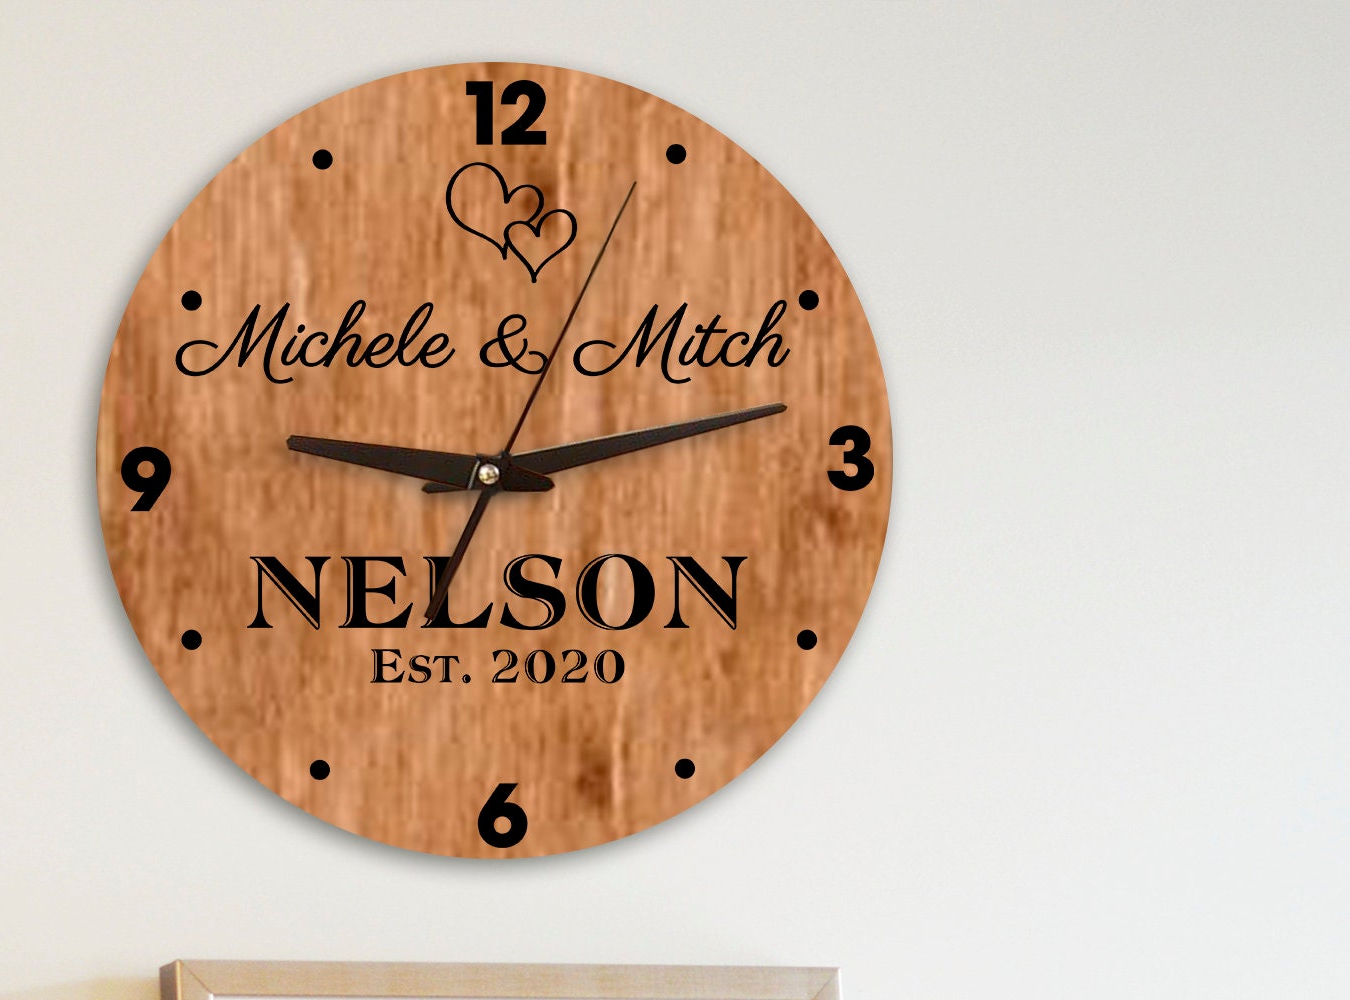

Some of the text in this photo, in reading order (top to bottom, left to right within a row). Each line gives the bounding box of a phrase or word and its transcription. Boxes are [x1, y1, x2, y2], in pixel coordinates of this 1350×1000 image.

[465, 79, 547, 146] 12
[175, 299, 792, 385] Michele & Mitch
[120, 446, 172, 512] 9
[826, 424, 875, 492] 3
[246, 552, 749, 631] NELSON
[491, 649, 625, 684] 2020
[477, 782, 528, 849] 6
